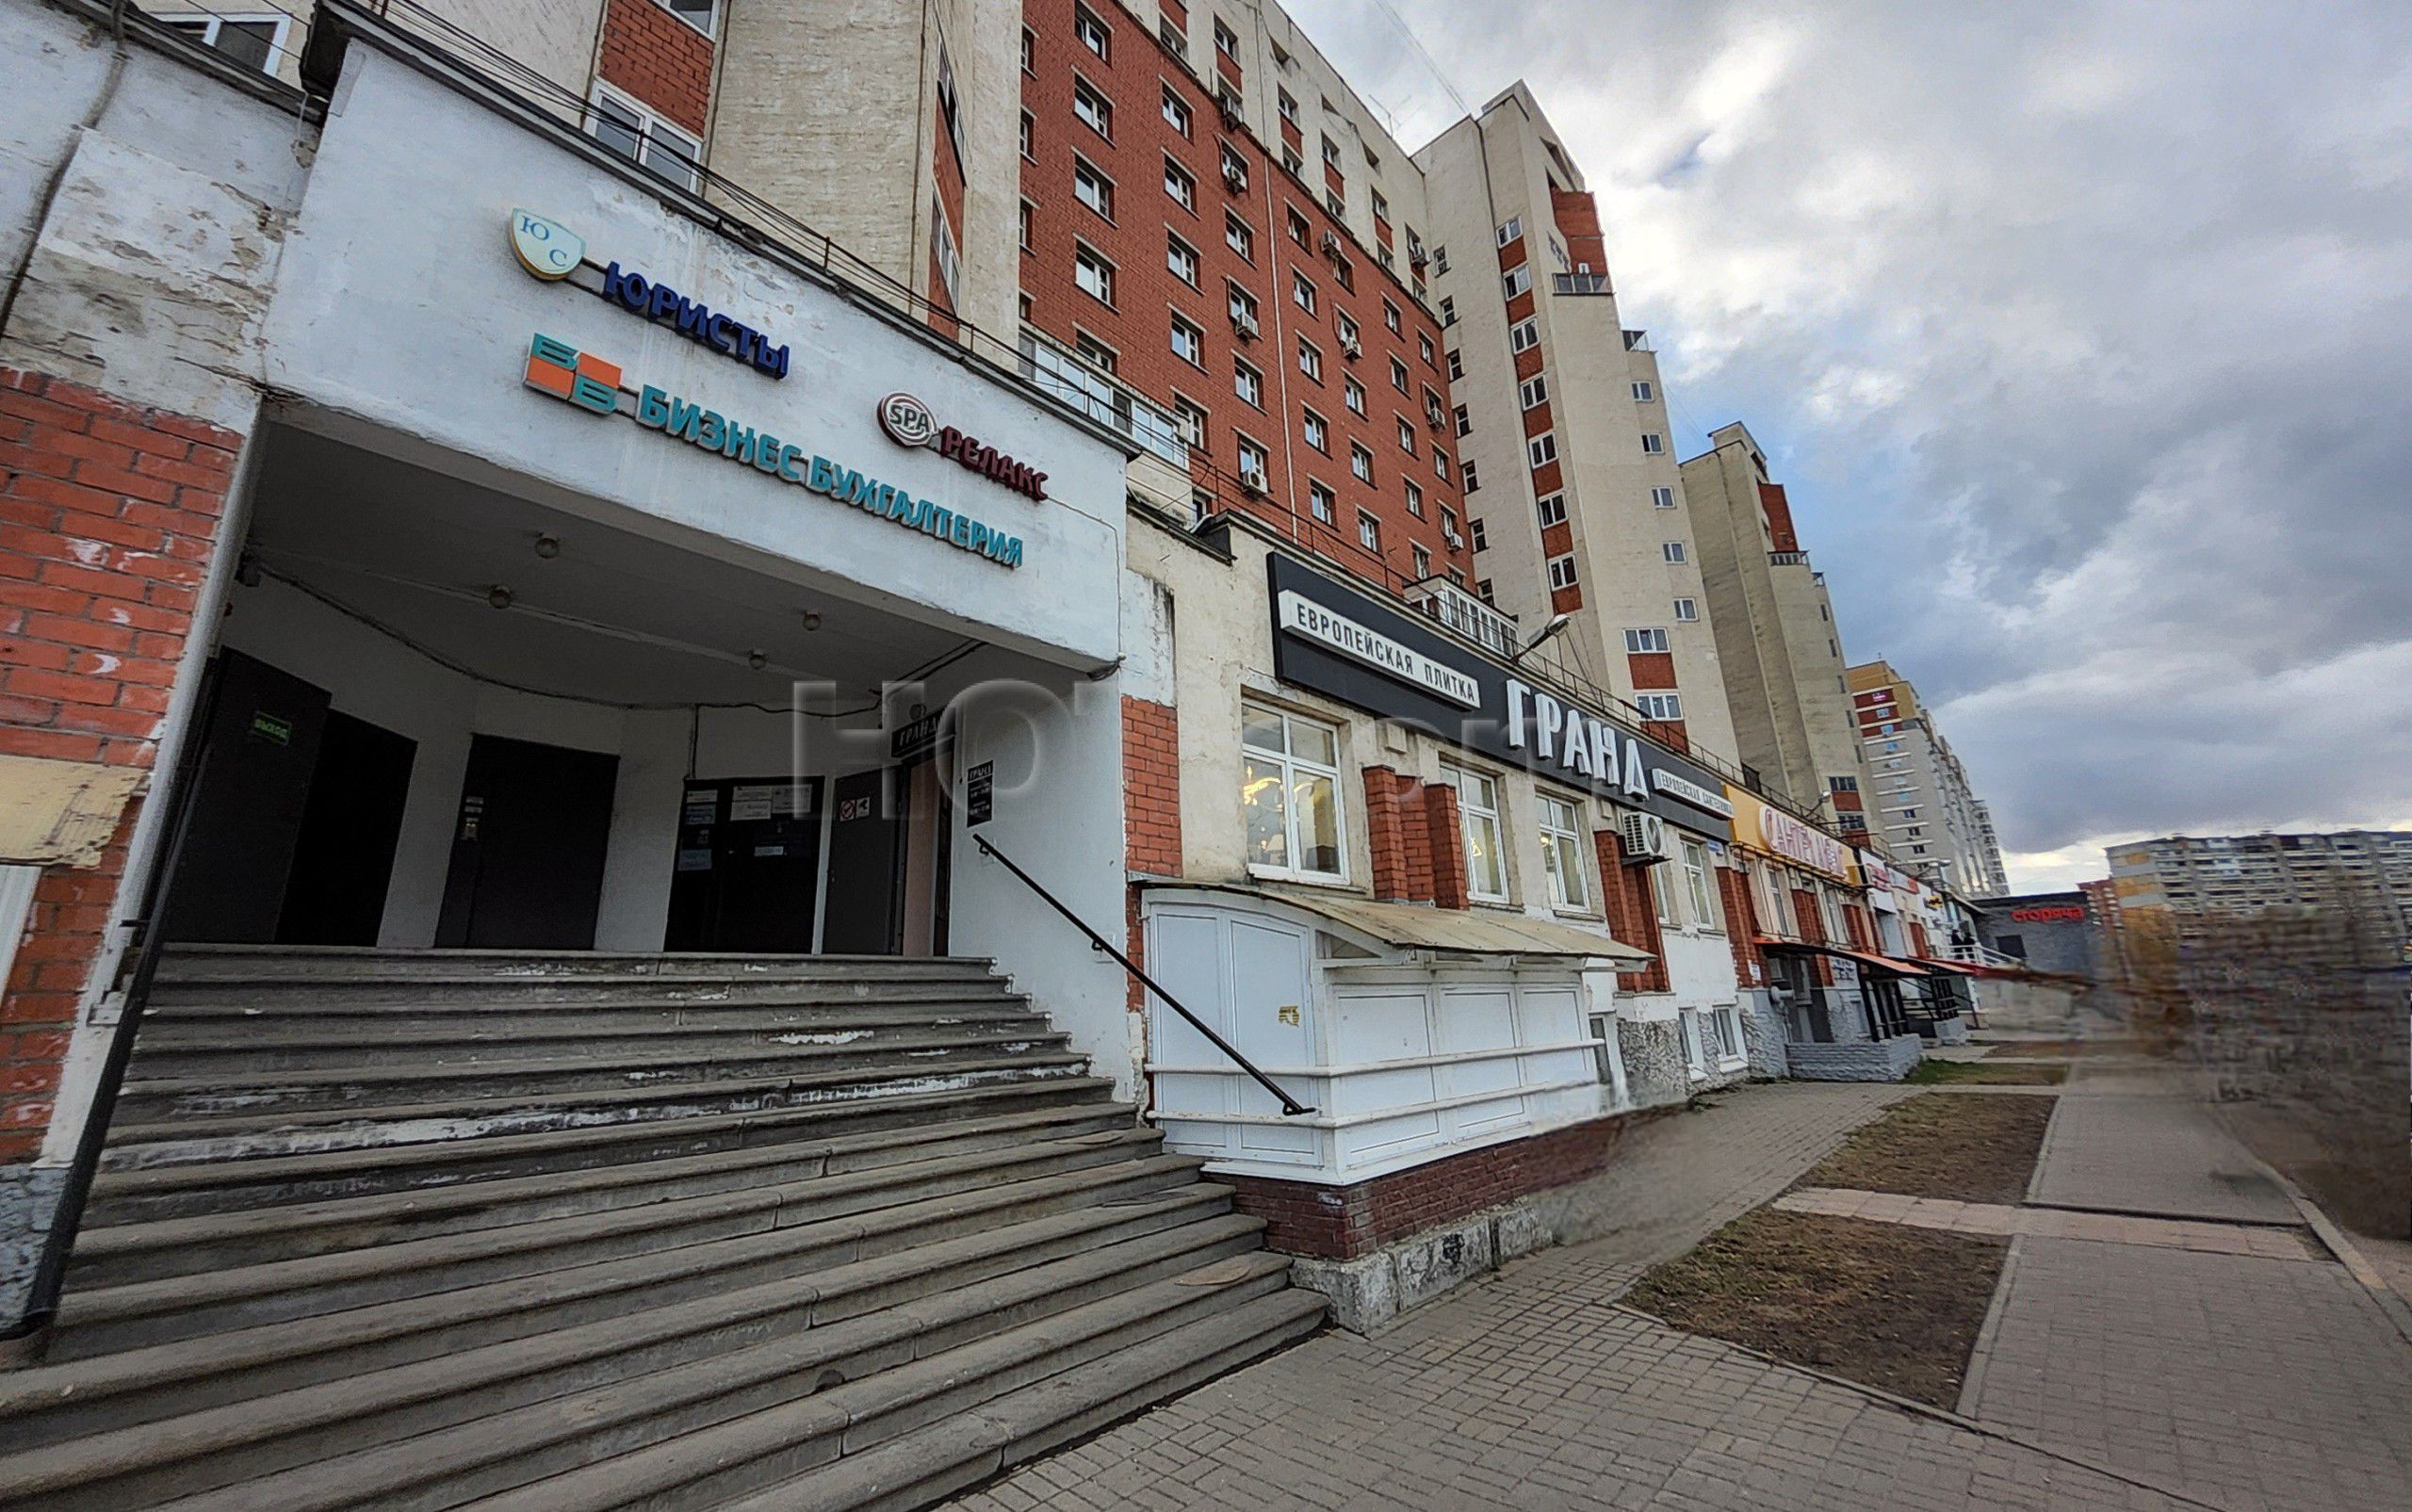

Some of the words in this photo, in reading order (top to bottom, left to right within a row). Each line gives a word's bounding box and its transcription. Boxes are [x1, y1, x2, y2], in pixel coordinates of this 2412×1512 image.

[602, 260, 790, 380] ЮРИСТЫ
[889, 404, 930, 433] SPA
[940, 425, 1049, 503] РЕЛАКС
[636, 383, 804, 481] БИЗНЕС
[807, 454, 1024, 569] БУХГАЛТЕРИЯ
[1296, 602, 1414, 675] ЕВРОПЕЙСКАЯ
[1424, 661, 1476, 703] ПЛИТКА
[899, 716, 937, 747] ГРАНД
[1506, 677, 1650, 801] ГРАНД
